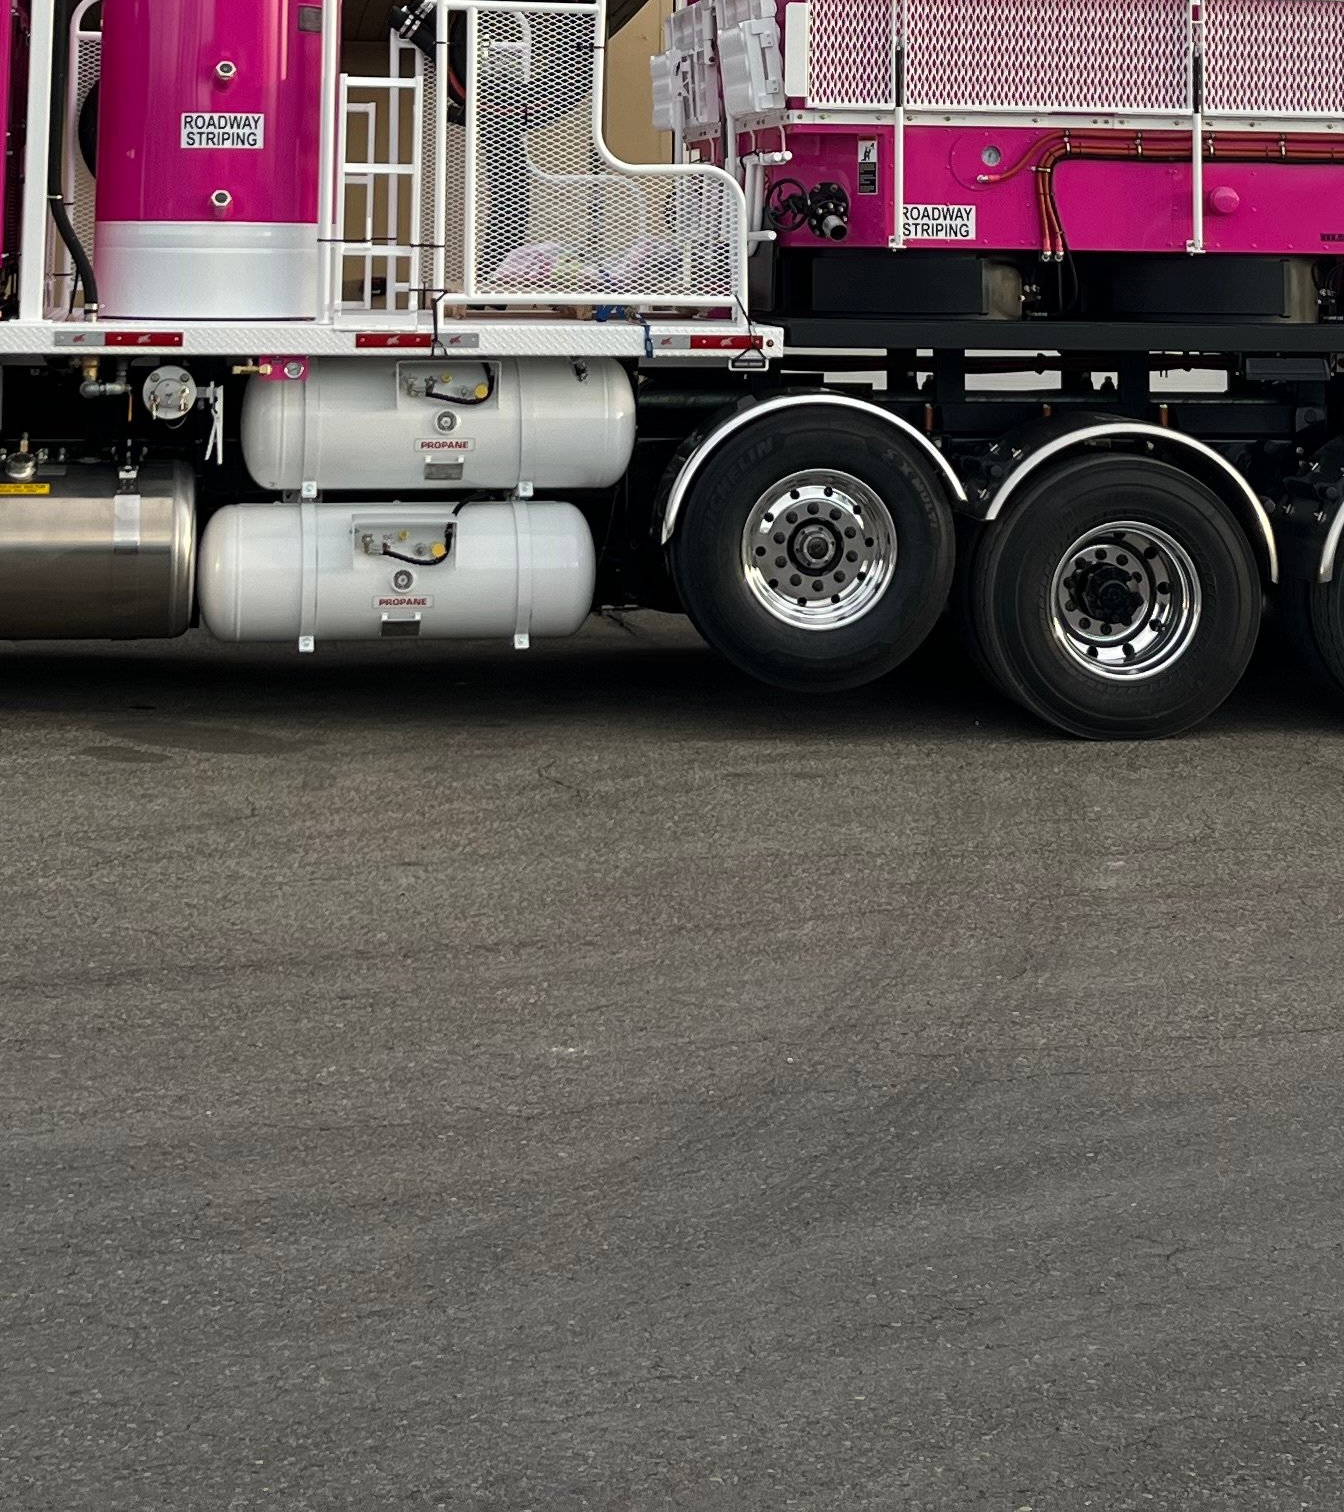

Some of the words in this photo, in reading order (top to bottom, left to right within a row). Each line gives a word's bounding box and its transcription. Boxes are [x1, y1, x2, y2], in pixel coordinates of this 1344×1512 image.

[183, 115, 262, 130] ROADWAY
[186, 131, 258, 147] STRIPING
[903, 206, 973, 222] ROADWAY
[903, 222, 970, 238] STRIPING
[420, 441, 469, 449] PROPANE
[379, 598, 428, 606] PROPANE
